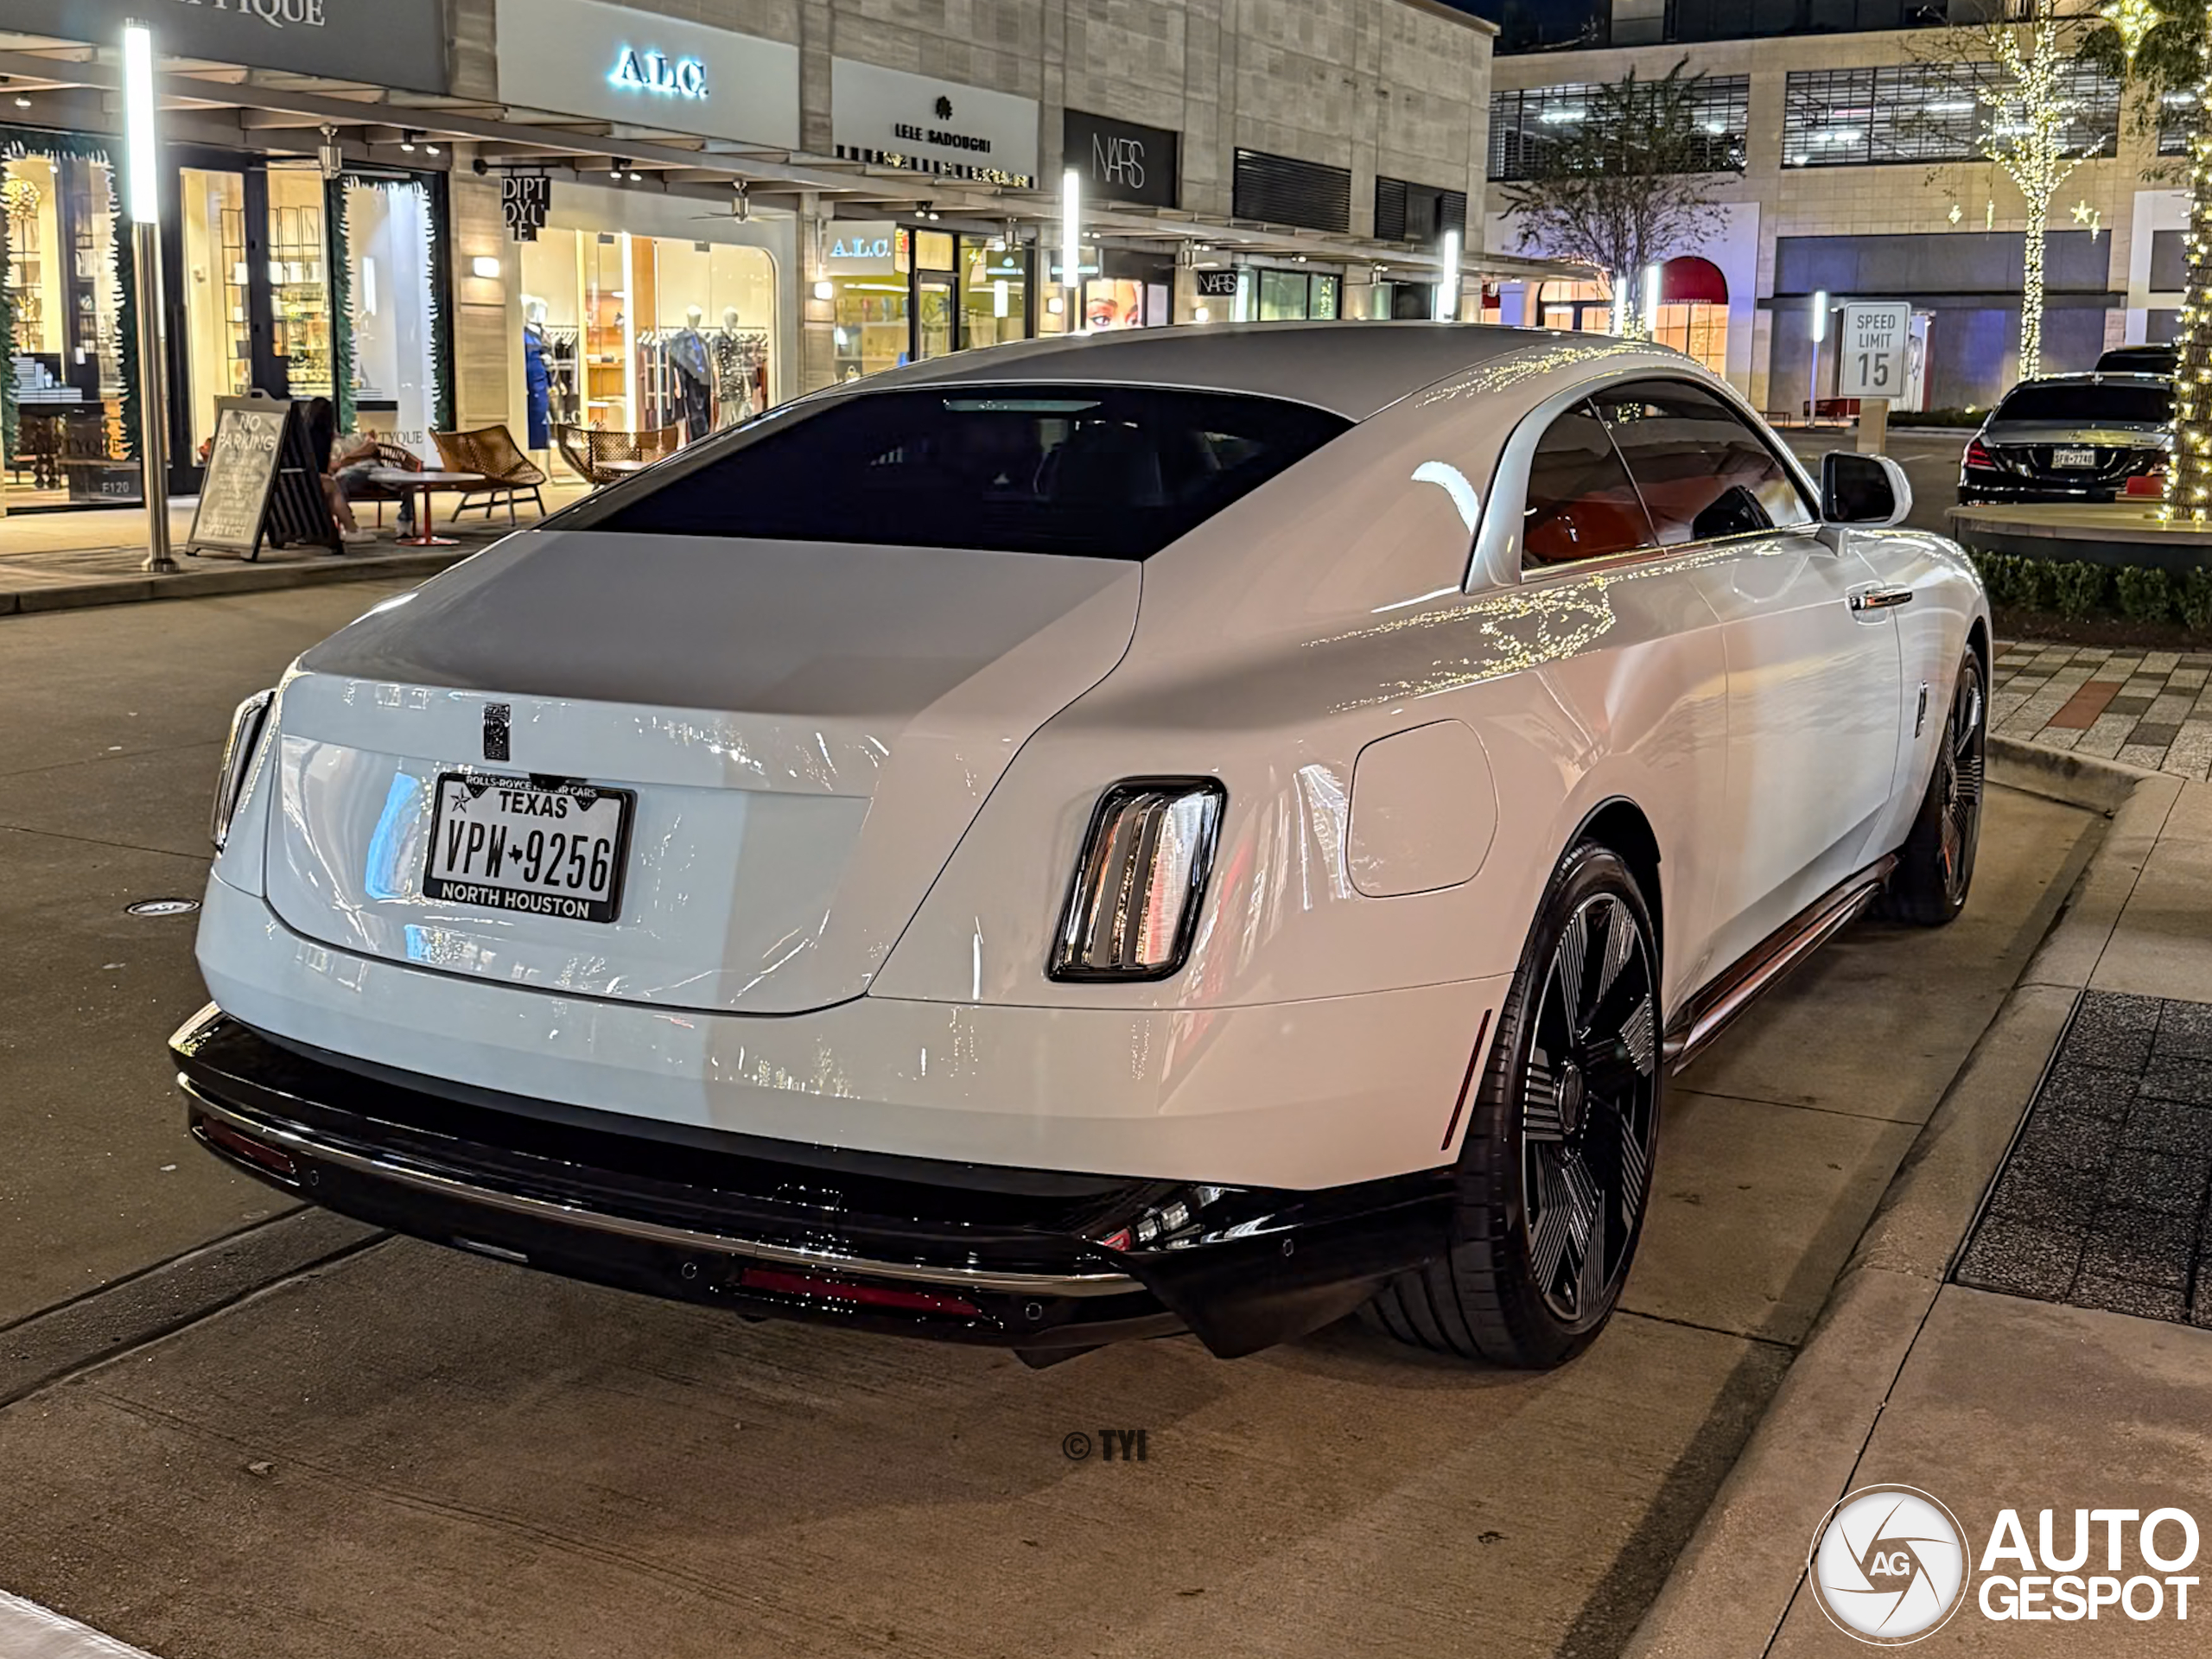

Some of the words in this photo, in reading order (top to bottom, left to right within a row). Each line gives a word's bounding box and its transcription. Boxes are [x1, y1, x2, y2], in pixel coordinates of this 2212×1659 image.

[613, 49, 709, 97] A.L.C.
[895, 123, 923, 142] LELE
[928, 130, 991, 154] SADOUGHI
[1092, 132, 1146, 189] NARS
[502, 177, 546, 200] DIPT
[830, 238, 892, 257] A.L.C.
[1198, 273, 1236, 293] NARS
[1857, 314, 1896, 329] SPEED
[1859, 334, 1892, 348] LIMIT
[1858, 353, 1890, 387] 15
[238, 415, 262, 432] NO
[218, 433, 276, 452] PARKING
[466, 775, 532, 791] ROLLS-ROYCE
[570, 785, 597, 798] CARS
[499, 790, 569, 819] TEXAS
[442, 882, 500, 906] NORTH
[504, 891, 590, 919] HOUSTON
